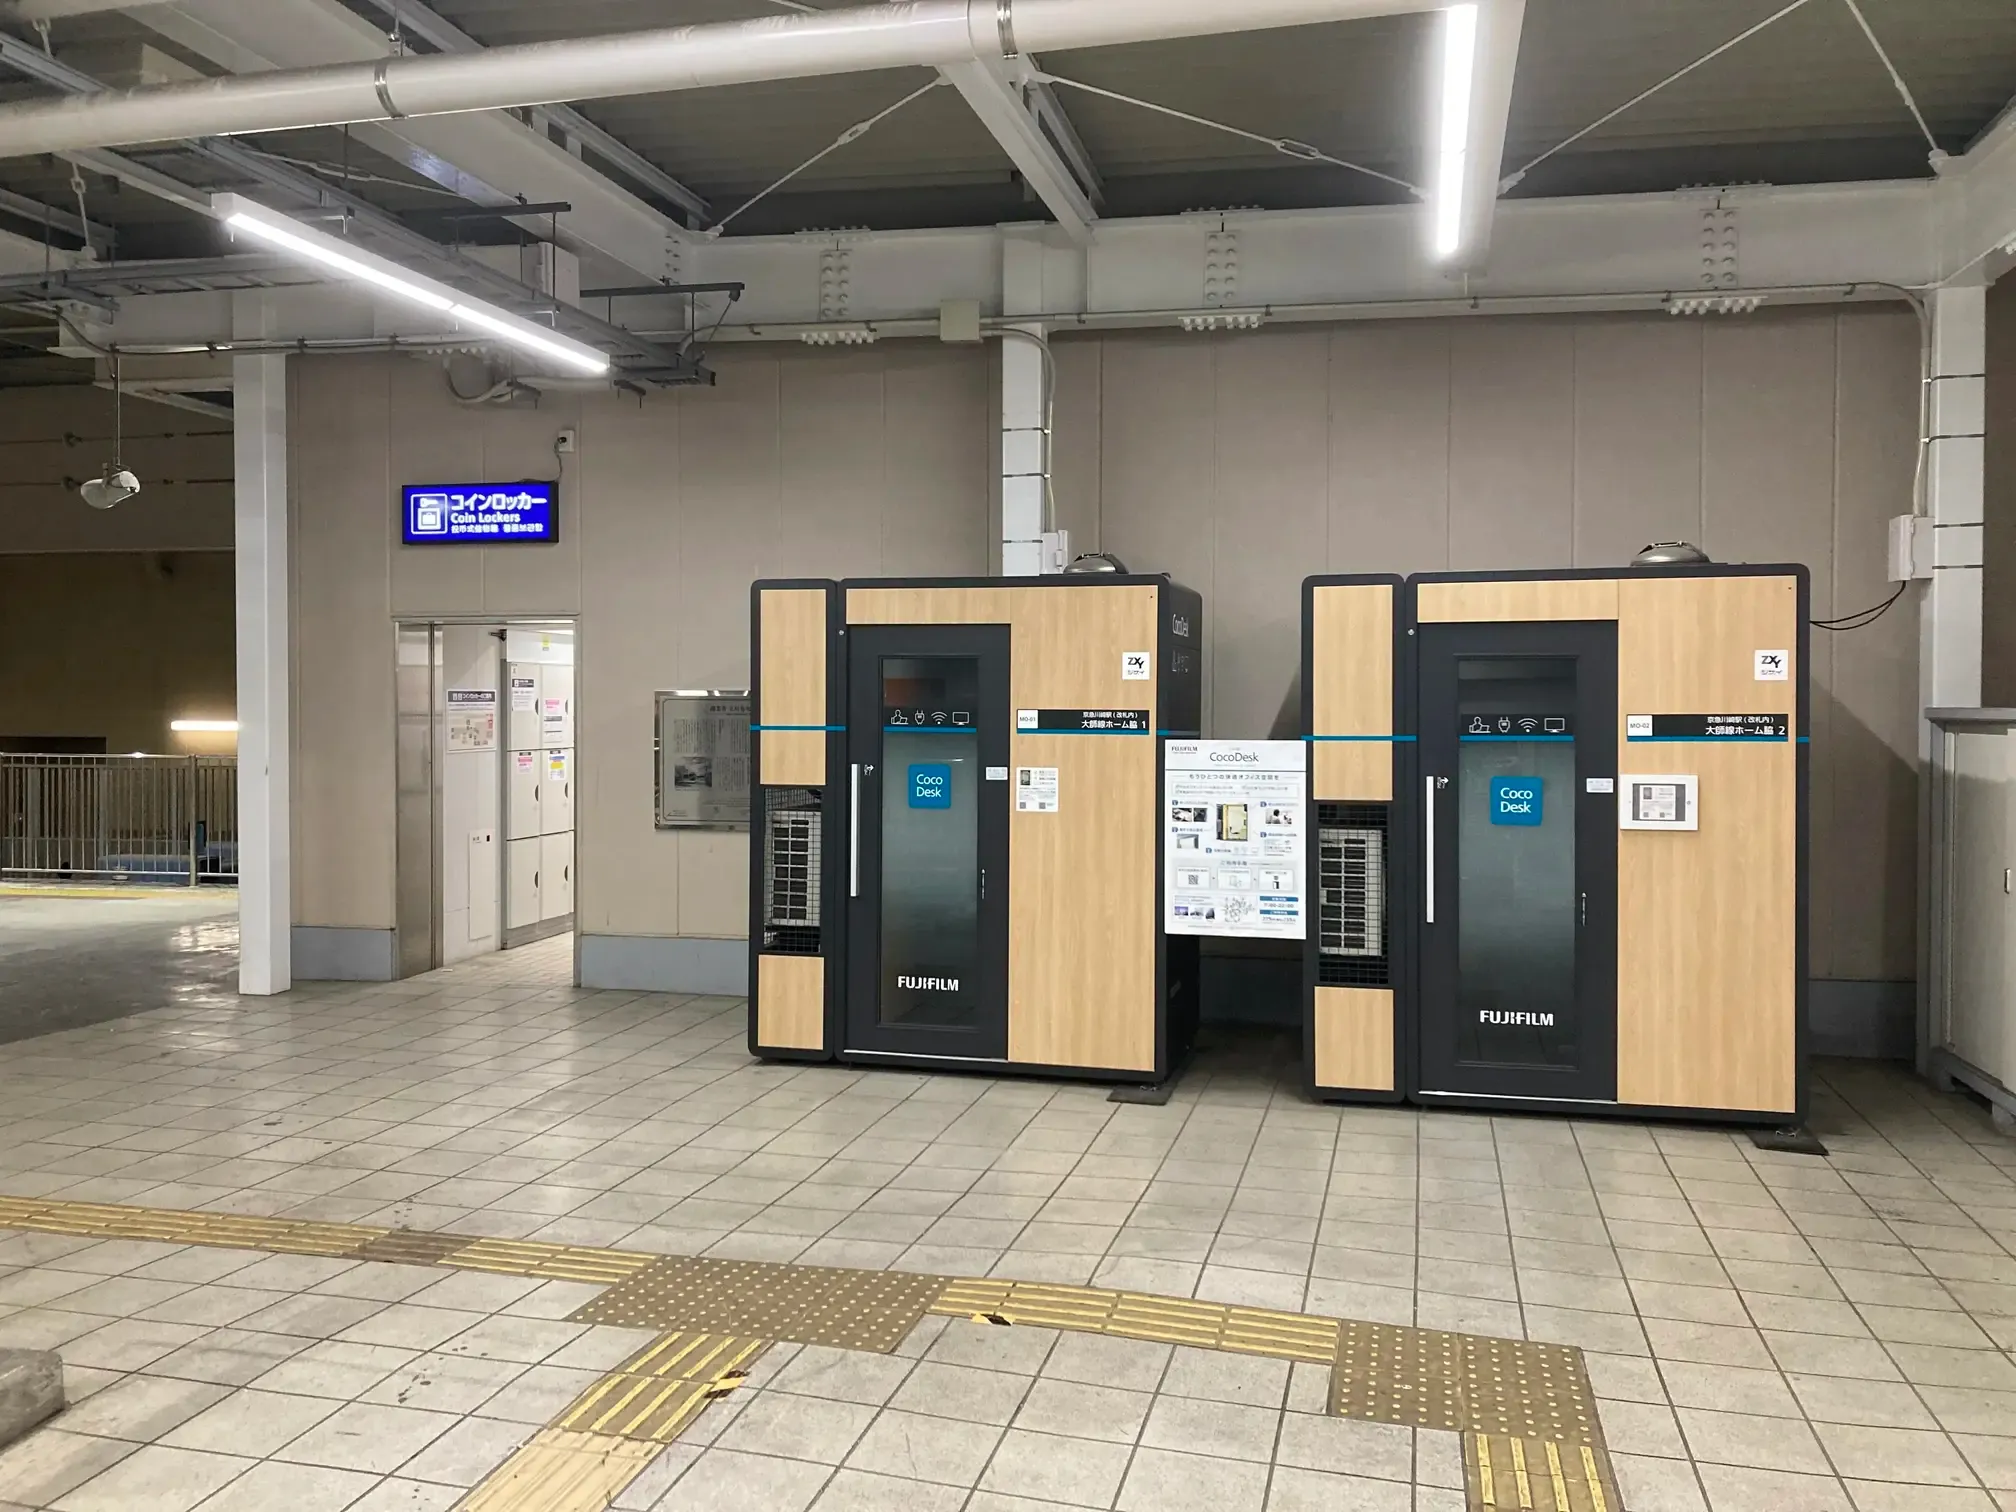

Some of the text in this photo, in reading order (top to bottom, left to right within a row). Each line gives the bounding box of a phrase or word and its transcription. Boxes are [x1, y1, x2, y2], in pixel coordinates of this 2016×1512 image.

[450, 492, 547, 511] コインロッカー
[450, 511, 521, 523] Coin Lockers
[1128, 657, 1145, 669] ZXY
[1761, 655, 1782, 668] ZXY
[1141, 720, 1146, 729] 1
[1778, 725, 1786, 735] 2
[1209, 752, 1260, 762] CocoDesk
[916, 774, 943, 785] Coco
[916, 786, 942, 797] Desk
[1500, 787, 1533, 800] Coco
[1500, 801, 1532, 813] Desk
[897, 975, 959, 991] FUJIFILM
[1479, 1010, 1554, 1026] FUJIFILM
